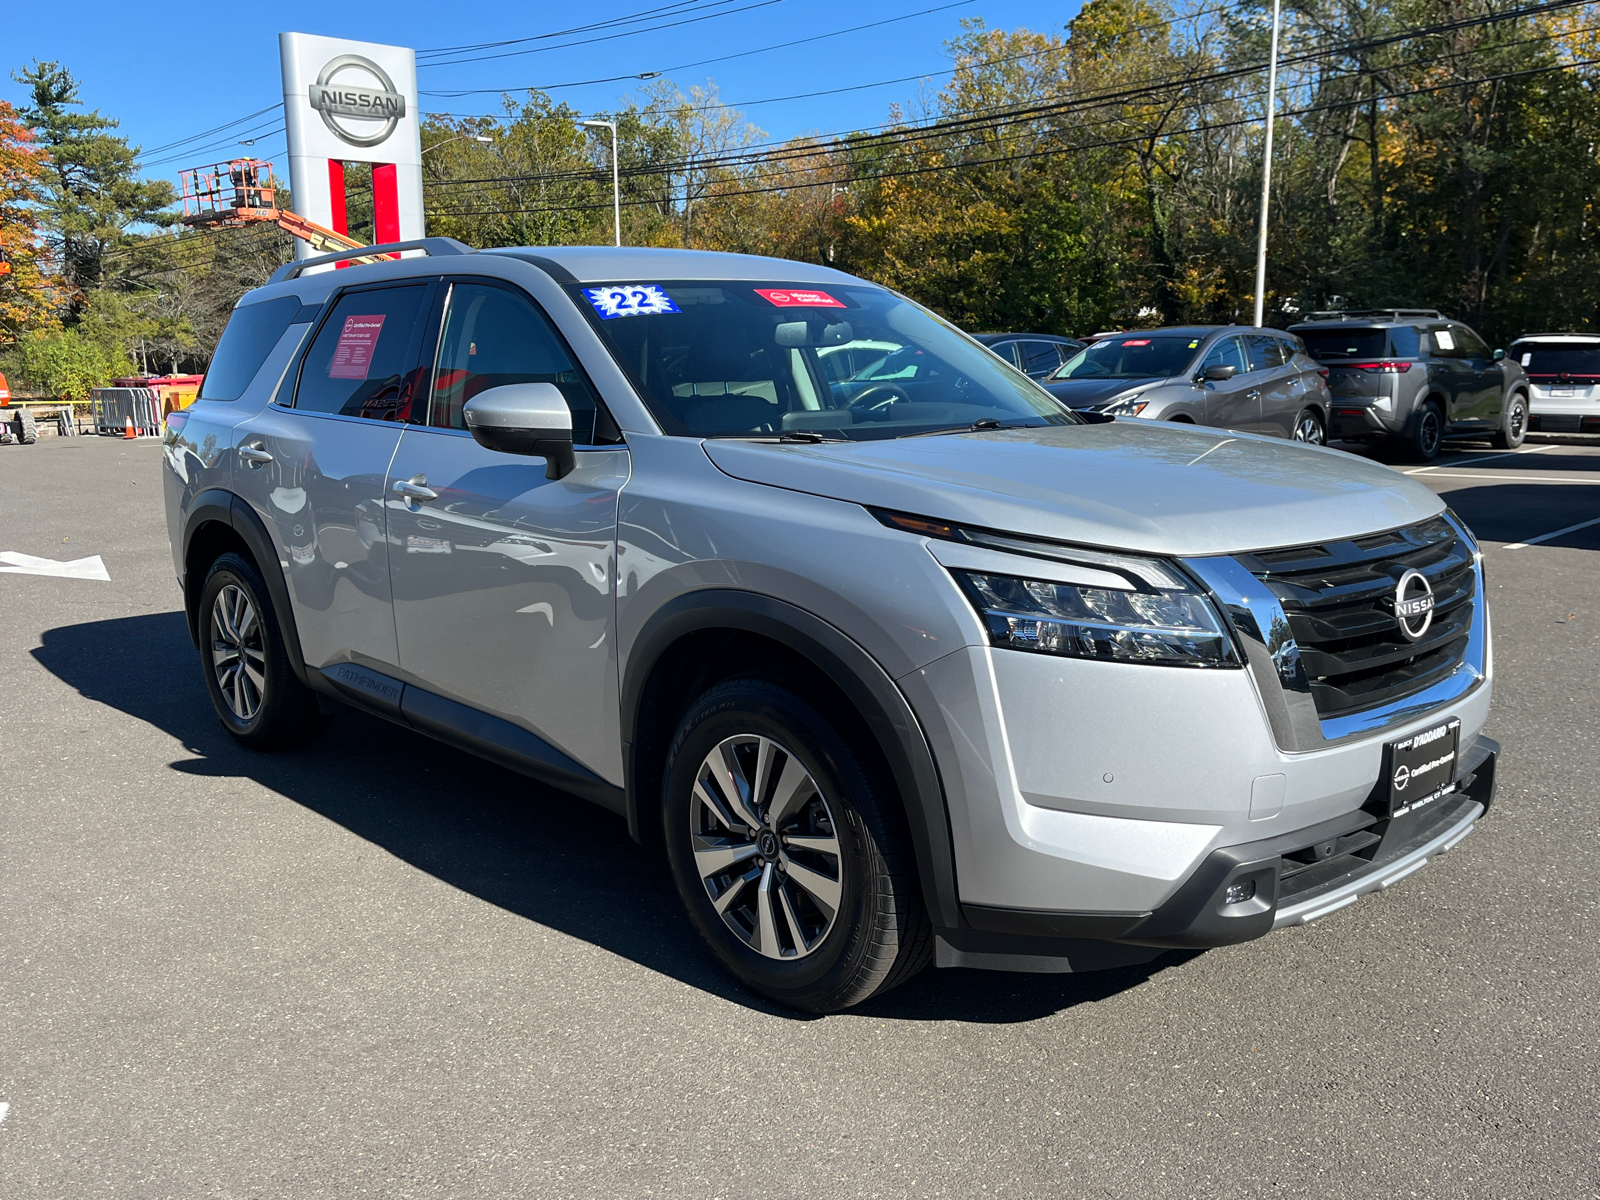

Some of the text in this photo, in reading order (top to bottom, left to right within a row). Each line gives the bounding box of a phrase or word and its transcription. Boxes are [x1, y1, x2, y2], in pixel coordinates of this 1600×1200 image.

[321, 89, 398, 111] NISSAN
[609, 290, 654, 310] 22
[1396, 596, 1435, 616] NISSAN
[336, 667, 399, 699] PATHFINDER
[1411, 761, 1432, 778] Certified
